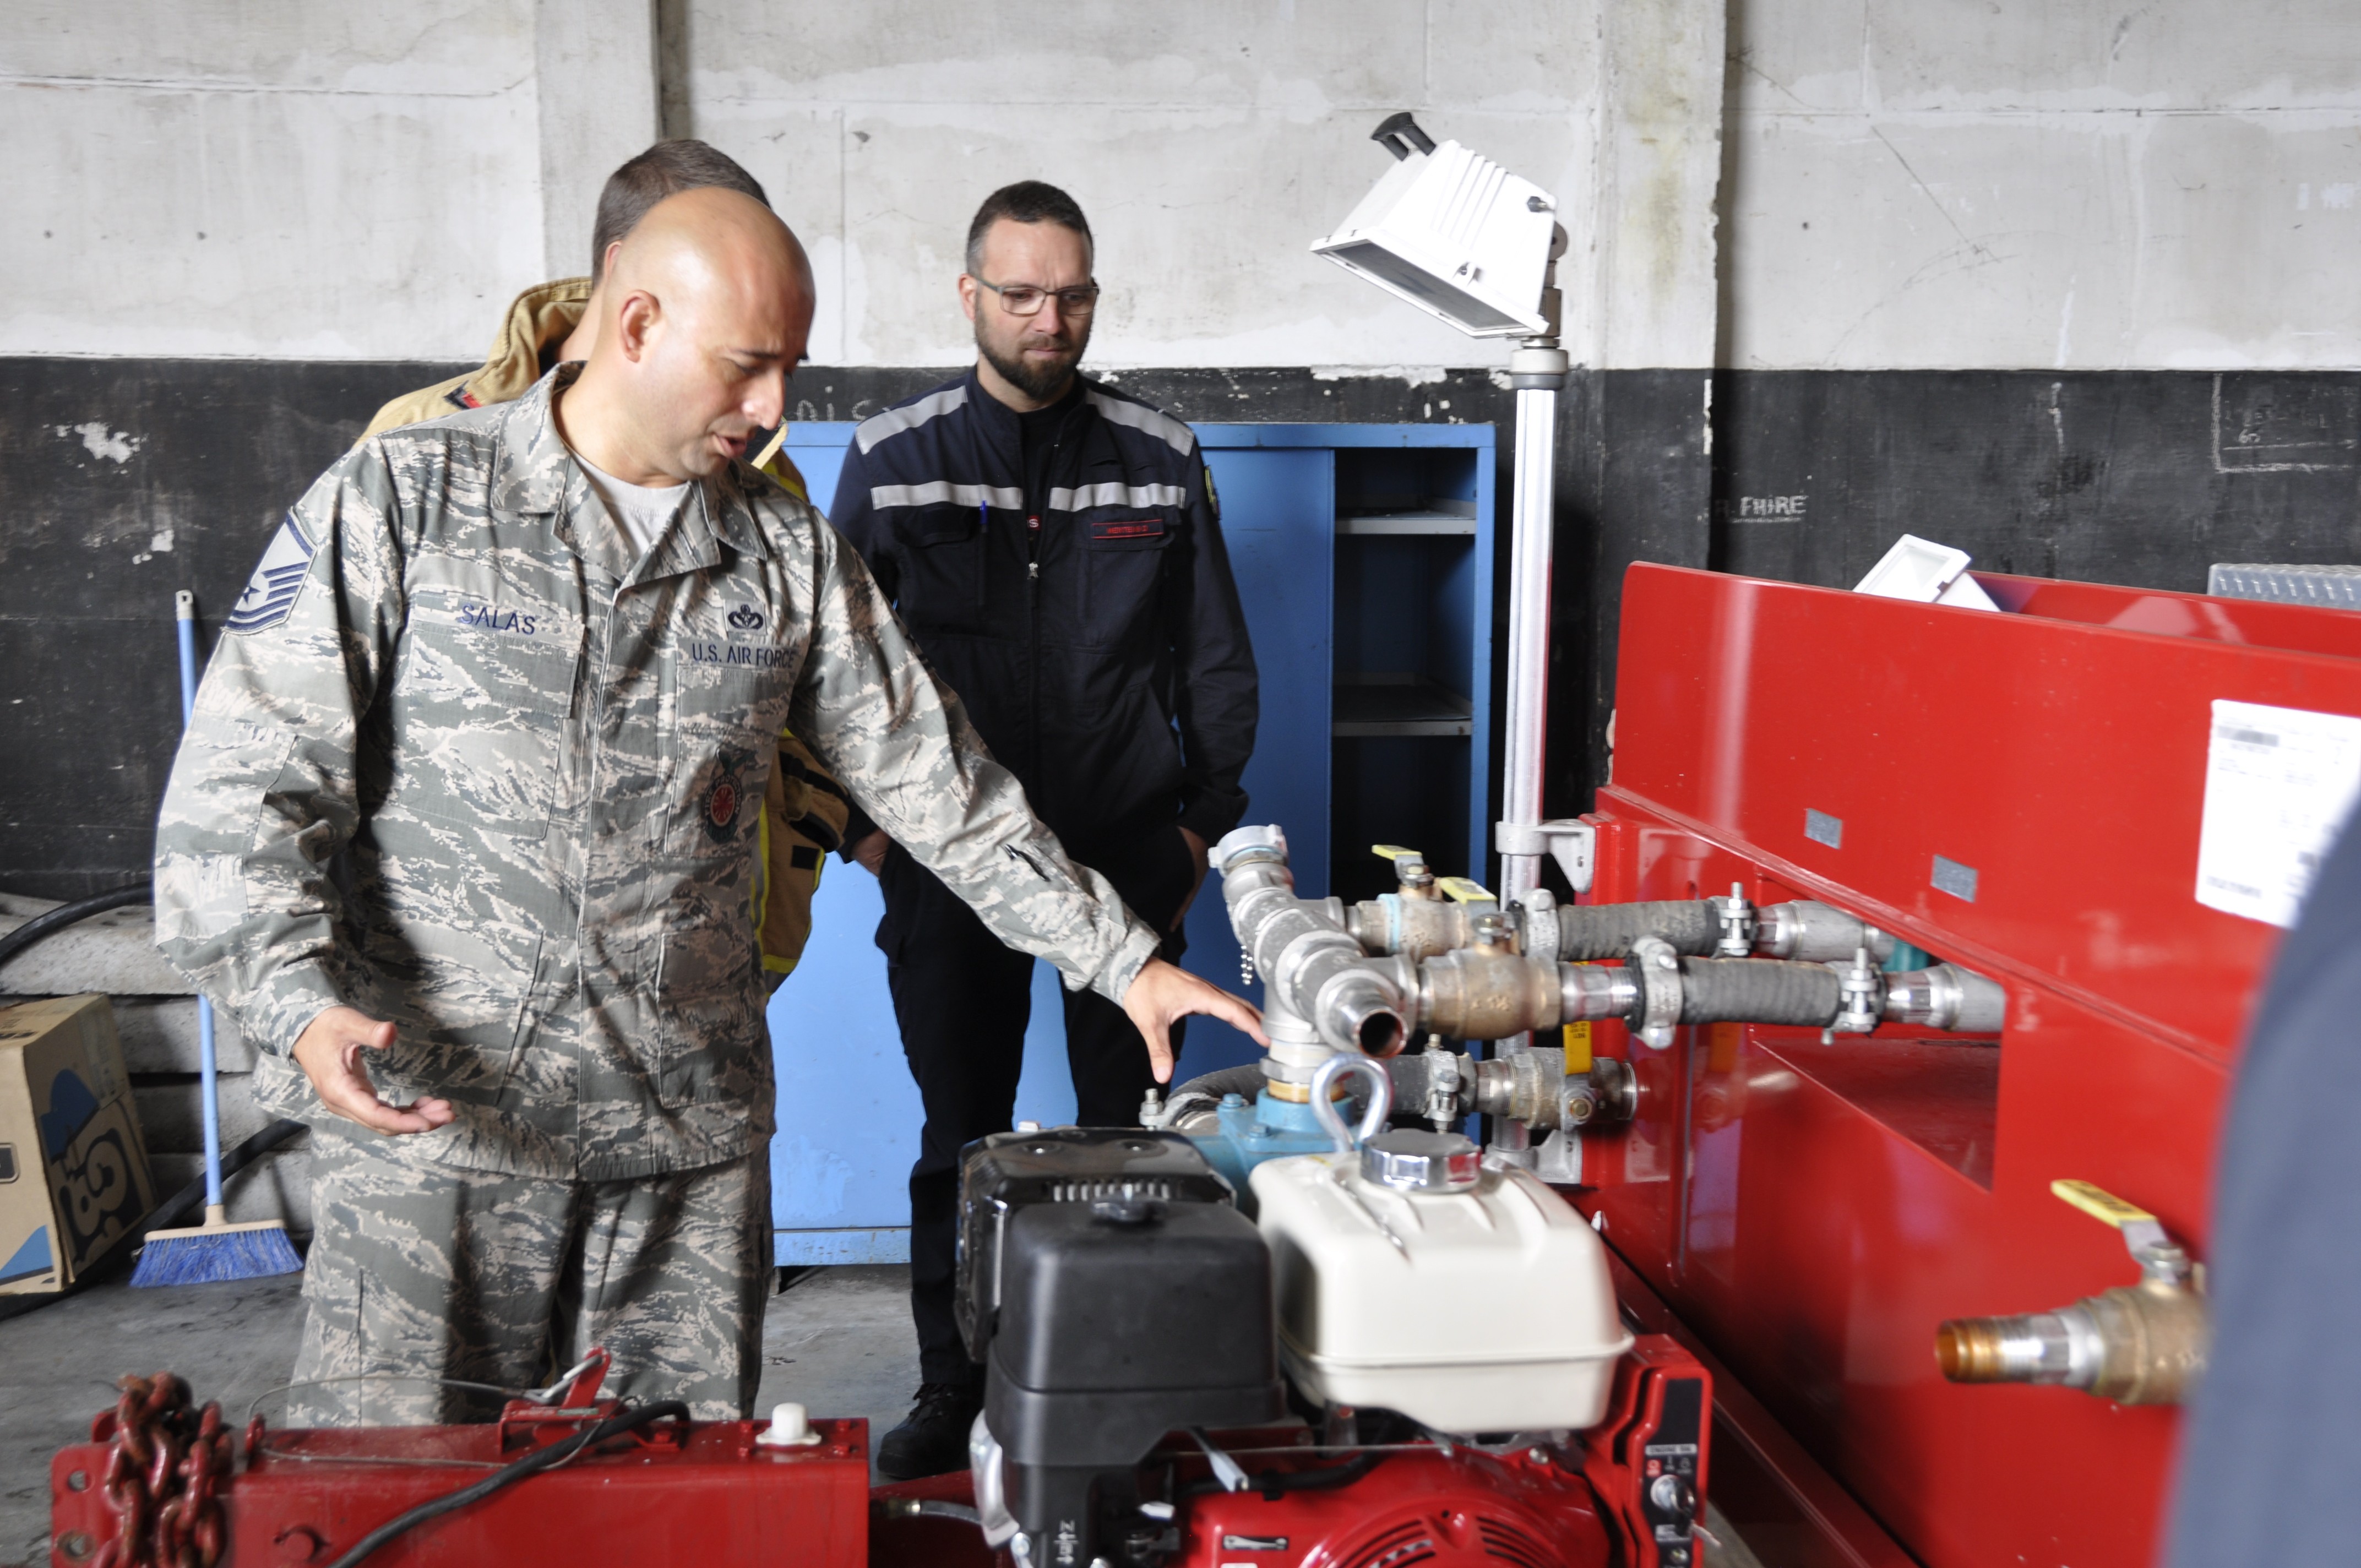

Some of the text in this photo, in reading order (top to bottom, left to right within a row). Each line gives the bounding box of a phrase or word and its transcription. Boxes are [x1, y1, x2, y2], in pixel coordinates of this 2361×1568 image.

[460, 603, 535, 635] SALAS
[692, 643, 796, 669] U.S. AIR FORCE
